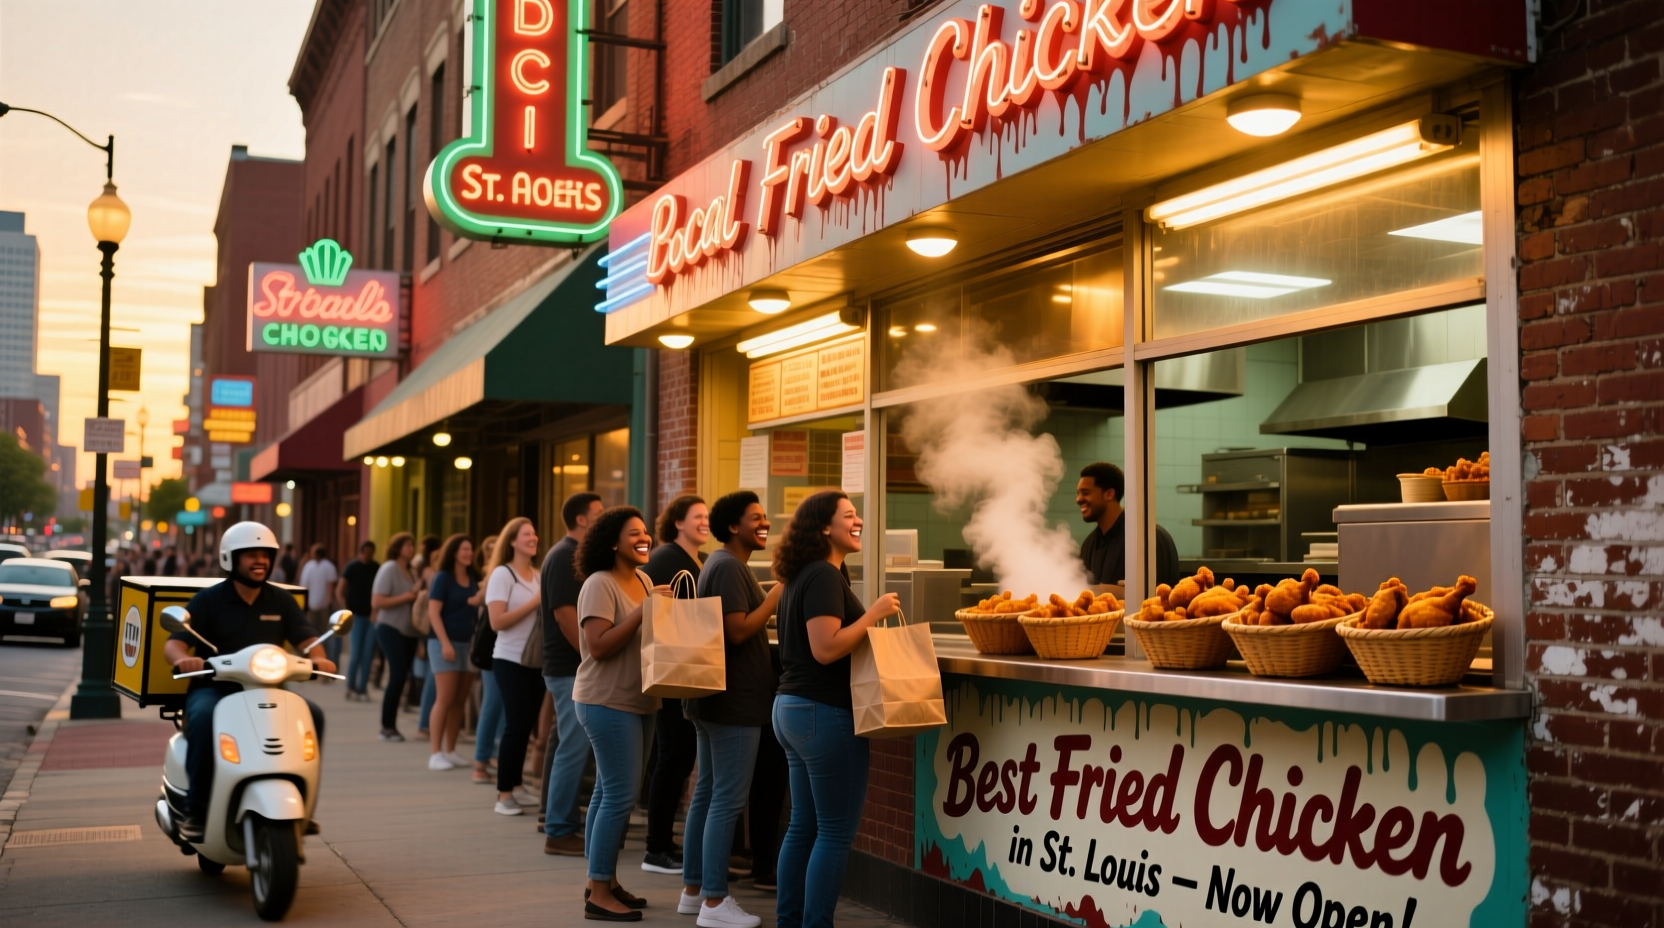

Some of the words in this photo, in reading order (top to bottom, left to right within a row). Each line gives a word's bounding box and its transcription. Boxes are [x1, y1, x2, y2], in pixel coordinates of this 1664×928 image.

[757, 67, 905, 235] Fried
[914, 0, 1241, 152] Chicke
[942, 732, 1040, 817] Best
[1050, 734, 1185, 835] Fried
[1193, 743, 1472, 887] Chicken
[1008, 824, 1033, 867] in
[1039, 830, 1076, 877] St.
[1084, 838, 1162, 898] Louis
[1205, 864, 1284, 924] Now
